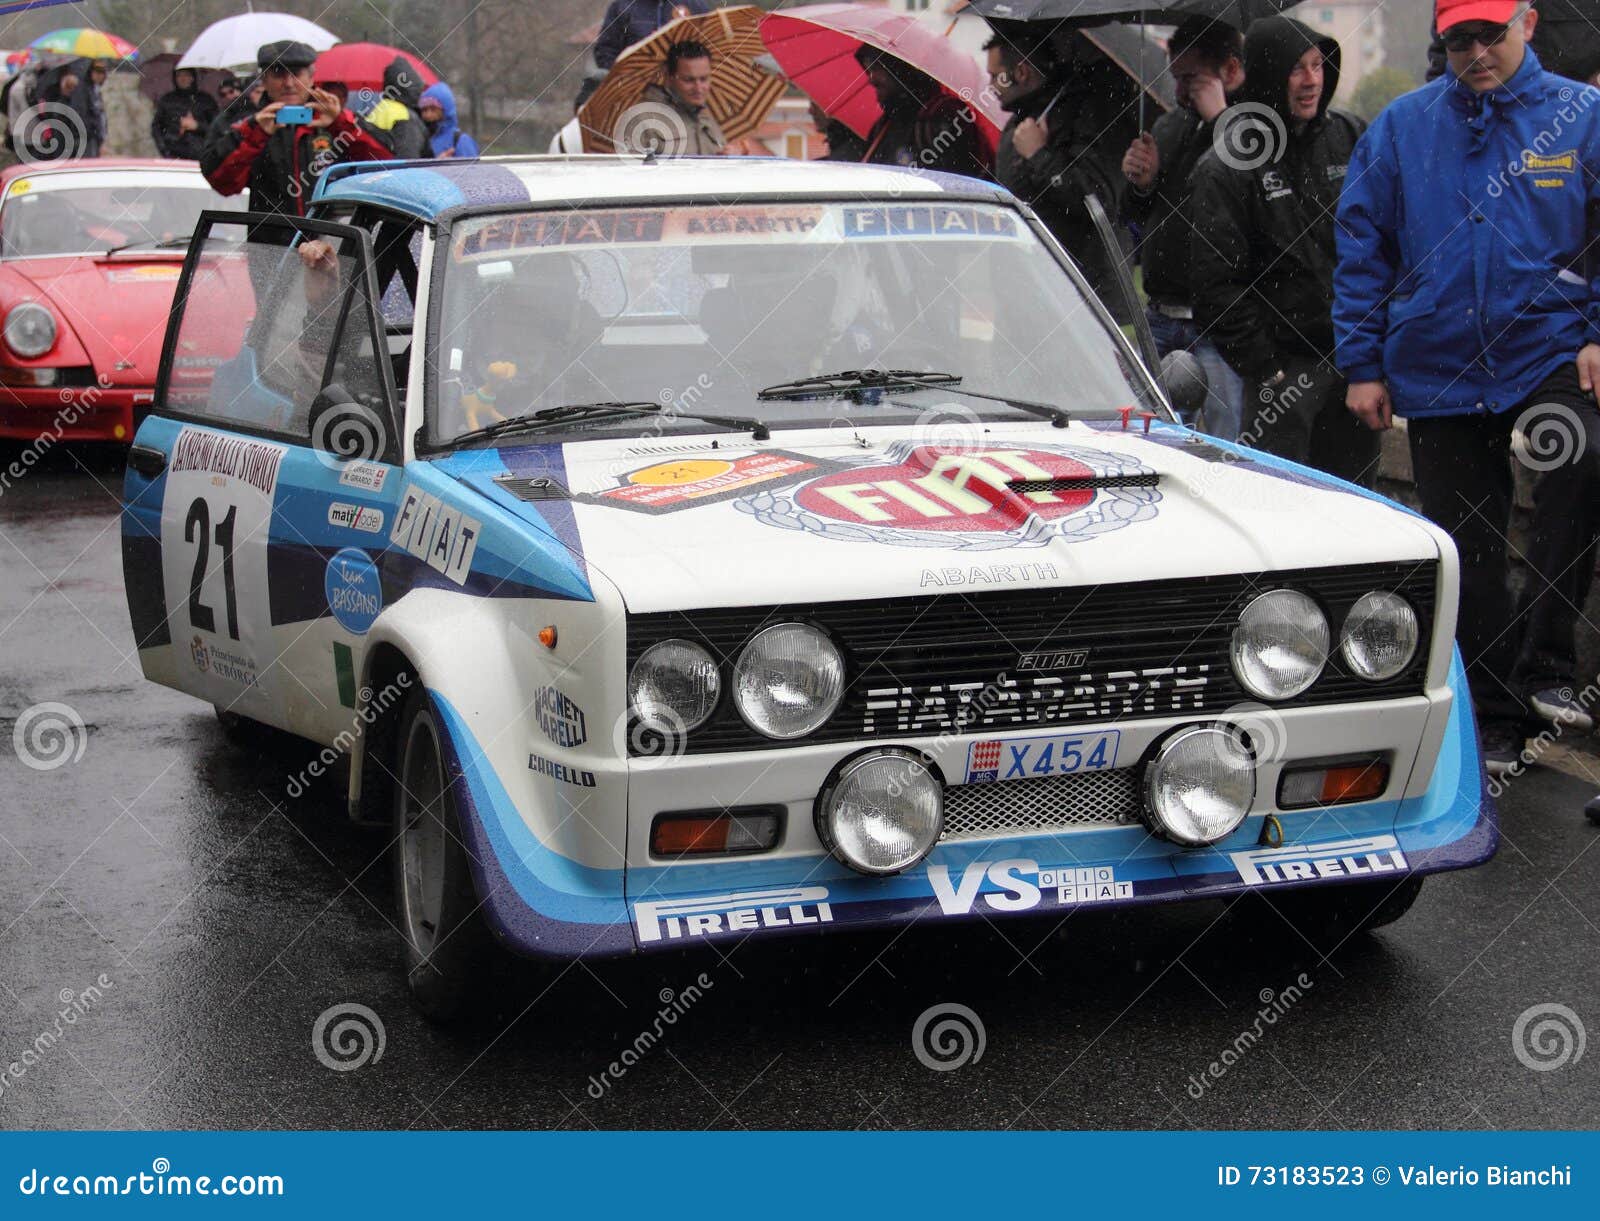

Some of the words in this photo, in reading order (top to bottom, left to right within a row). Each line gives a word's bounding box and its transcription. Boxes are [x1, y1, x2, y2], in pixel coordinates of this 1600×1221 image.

[856, 210, 1007, 233] FIAT
[211, 437, 246, 477] RALLY
[238, 443, 282, 494] STORICO
[815, 448, 1064, 522] FIAT
[396, 495, 475, 571] FIAT
[185, 496, 241, 642] 21
[340, 559, 366, 584] Team
[919, 560, 1059, 588] ABARTH
[331, 587, 379, 616] BASSANO
[1018, 652, 1088, 671] FIAT
[1005, 736, 1108, 780] X454
[1041, 868, 1110, 885] OLIO
[1230, 834, 1408, 886] PIRELLI
[926, 858, 1042, 915] VS
[1062, 882, 1130, 899] FIAT
[634, 886, 834, 942] PIRELLI
